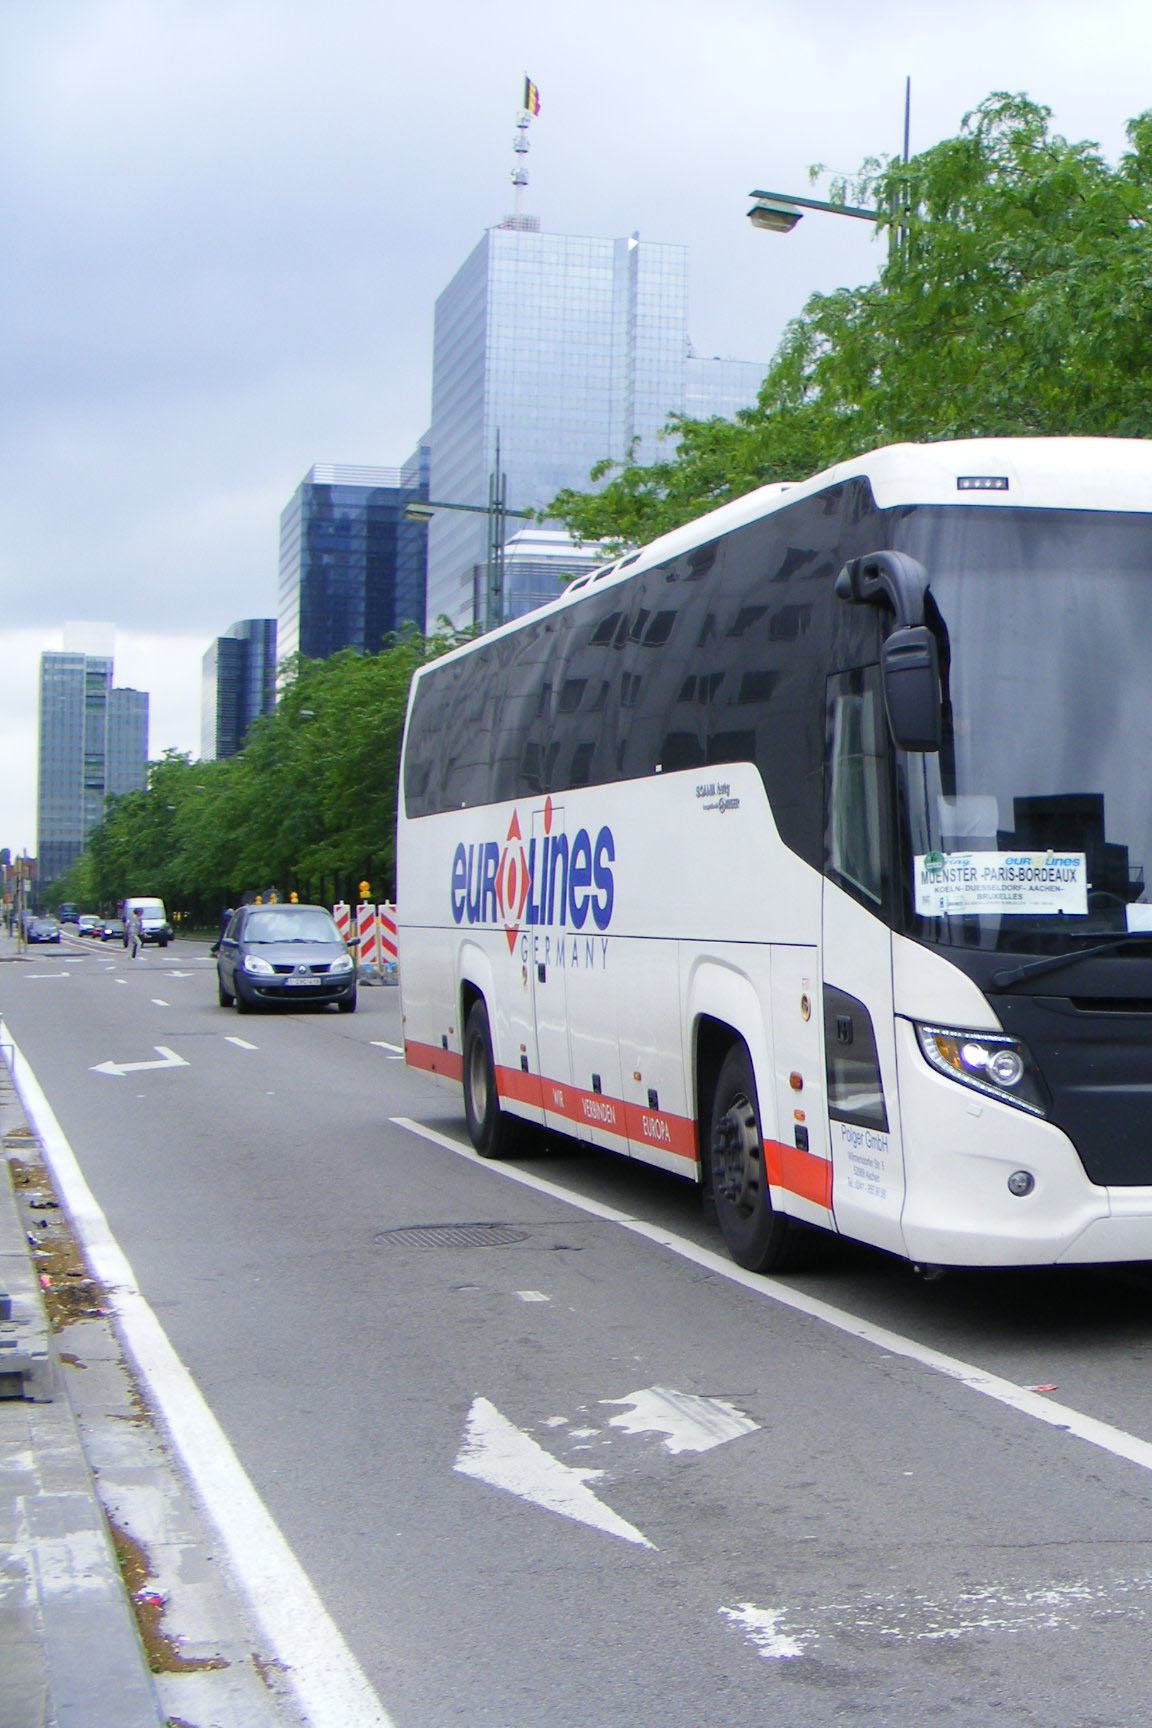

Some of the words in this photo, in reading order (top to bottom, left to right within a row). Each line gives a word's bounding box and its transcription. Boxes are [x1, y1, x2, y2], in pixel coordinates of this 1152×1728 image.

[921, 867, 977, 885] MUENSTER
[520, 934, 608, 970] GERMANY
[552, 1088, 565, 1108] WIR
[581, 1098, 616, 1124] VERBINDEN
[642, 1115, 671, 1142] EUROPA
[865, 1130, 888, 1152] GmbH
